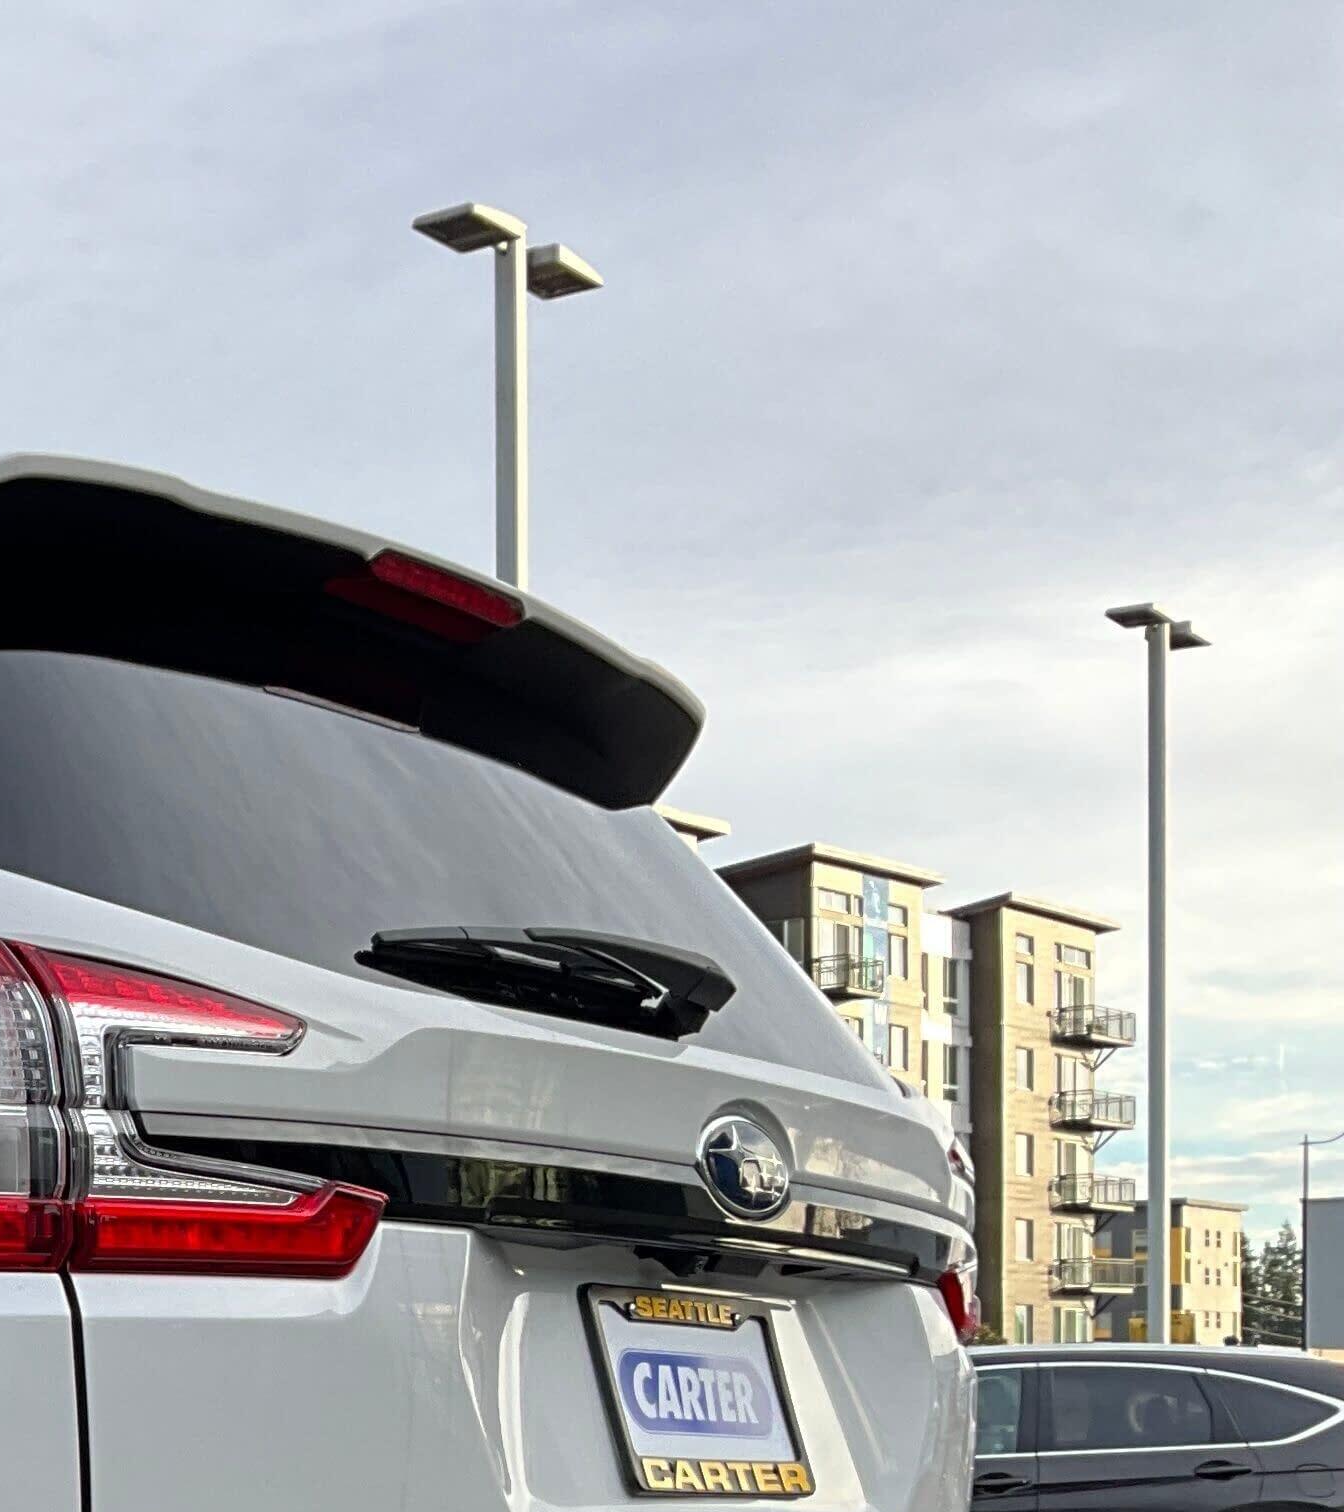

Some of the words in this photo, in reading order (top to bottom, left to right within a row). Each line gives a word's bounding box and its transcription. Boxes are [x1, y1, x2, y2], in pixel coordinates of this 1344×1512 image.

[635, 1296, 734, 1325] SEATTLE
[633, 1362, 759, 1424] CARTER
[642, 1458, 811, 1492] CARTER
